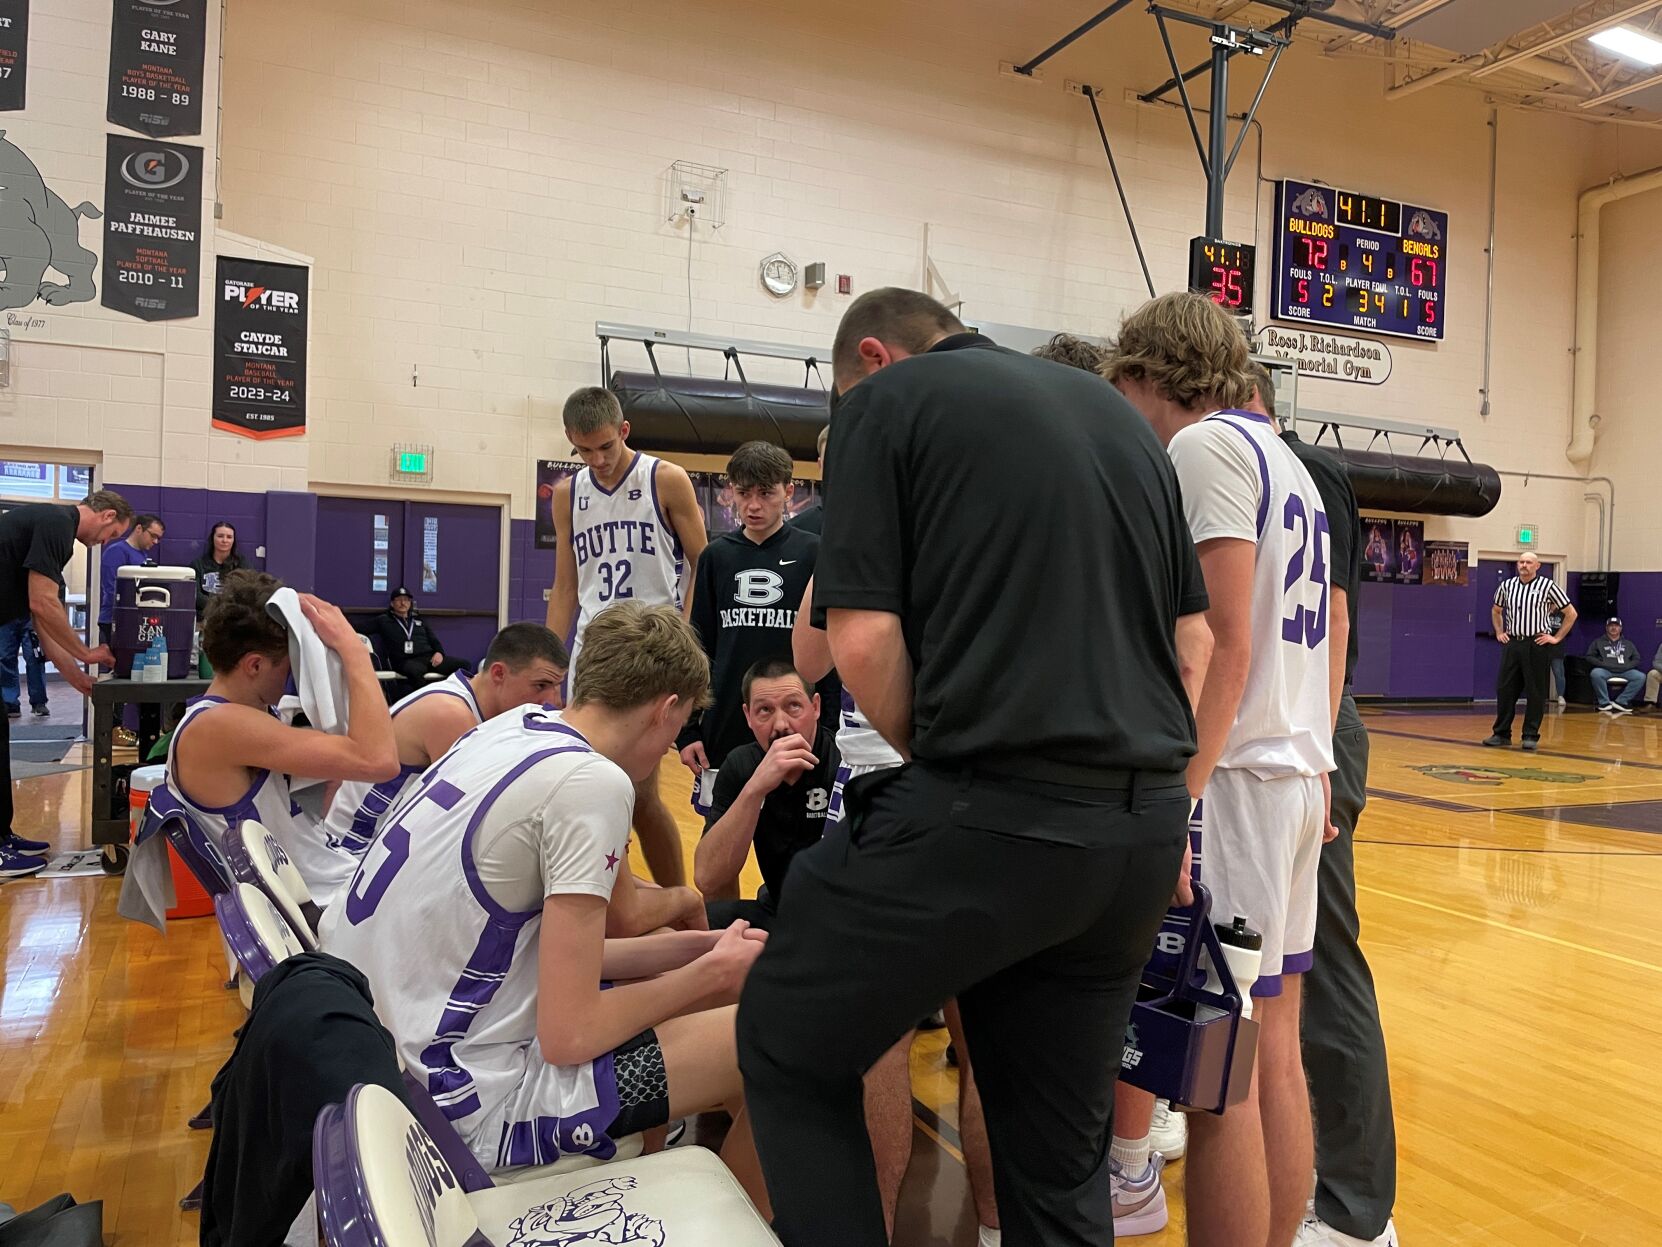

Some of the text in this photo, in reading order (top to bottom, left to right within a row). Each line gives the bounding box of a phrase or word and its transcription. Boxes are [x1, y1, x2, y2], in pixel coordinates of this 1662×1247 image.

[141, 29, 177, 43] GARY
[140, 40, 177, 55] KANE
[127, 69, 187, 84] BOYS BASKETBALL
[142, 63, 173, 74] MONTANA
[122, 75, 191, 93] PLAYER OF THE YEAR
[121, 85, 155, 101] 1988
[171, 92, 190, 106] 89
[130, 212, 177, 227] JAIMEE
[1340, 195, 1385, 228] 41.1
[110, 221, 195, 241] PAFFHAUSEN
[1288, 217, 1335, 240] BULLDOGS
[136, 247, 169, 258] MONTANA
[1355, 238, 1381, 252] PERIOD
[1402, 239, 1440, 259] BENGALS
[135, 255, 169, 266] SOFTBALL
[1204, 244, 1240, 268] 41.1
[1302, 238, 1328, 270] 72
[116, 260, 142, 270] PLAYER
[154, 264, 167, 273] THE
[168, 266, 188, 275] YEAR
[1362, 253, 1373, 273] 4
[119, 269, 154, 286] 2010
[170, 276, 184, 289] 11
[1289, 267, 1312, 281] FOULS
[1319, 273, 1338, 285] T.O.L.
[1411, 258, 1436, 287] 67
[1211, 267, 1242, 306] 35
[1298, 280, 1308, 303] 5
[1345, 277, 1388, 293] PLAYER FOUL
[1394, 285, 1412, 297] T.O.L.
[1323, 284, 1333, 307] 2
[1418, 289, 1438, 302] FOULS
[279, 307, 300, 315] YEAR
[1288, 305, 1311, 318] SCORE
[1403, 299, 1408, 318] 1
[1425, 301, 1435, 323] 5
[1353, 315, 1377, 327] MATCH
[240, 331, 283, 346] CAYDE
[1417, 325, 1437, 337] SCORE
[1267, 329, 1381, 360] Ross J. Richardson
[245, 361, 277, 371] MONTANA
[1275, 350, 1371, 381] morial Gym
[226, 375, 295, 388] PLAYER OF THE YEAR
[244, 369, 277, 379] BASEBALL
[229, 386, 291, 402] 2023-24
[628, 489, 642, 500] B
[575, 520, 656, 567] BUTTE
[1282, 492, 1330, 650] 25
[598, 559, 633, 602] 32
[733, 568, 784, 607] B
[137, 633, 163, 642] GE
[138, 625, 164, 635] KAN
[806, 787, 828, 811] B
[1157, 931, 1186, 955] B
[571, 1122, 594, 1147] B
